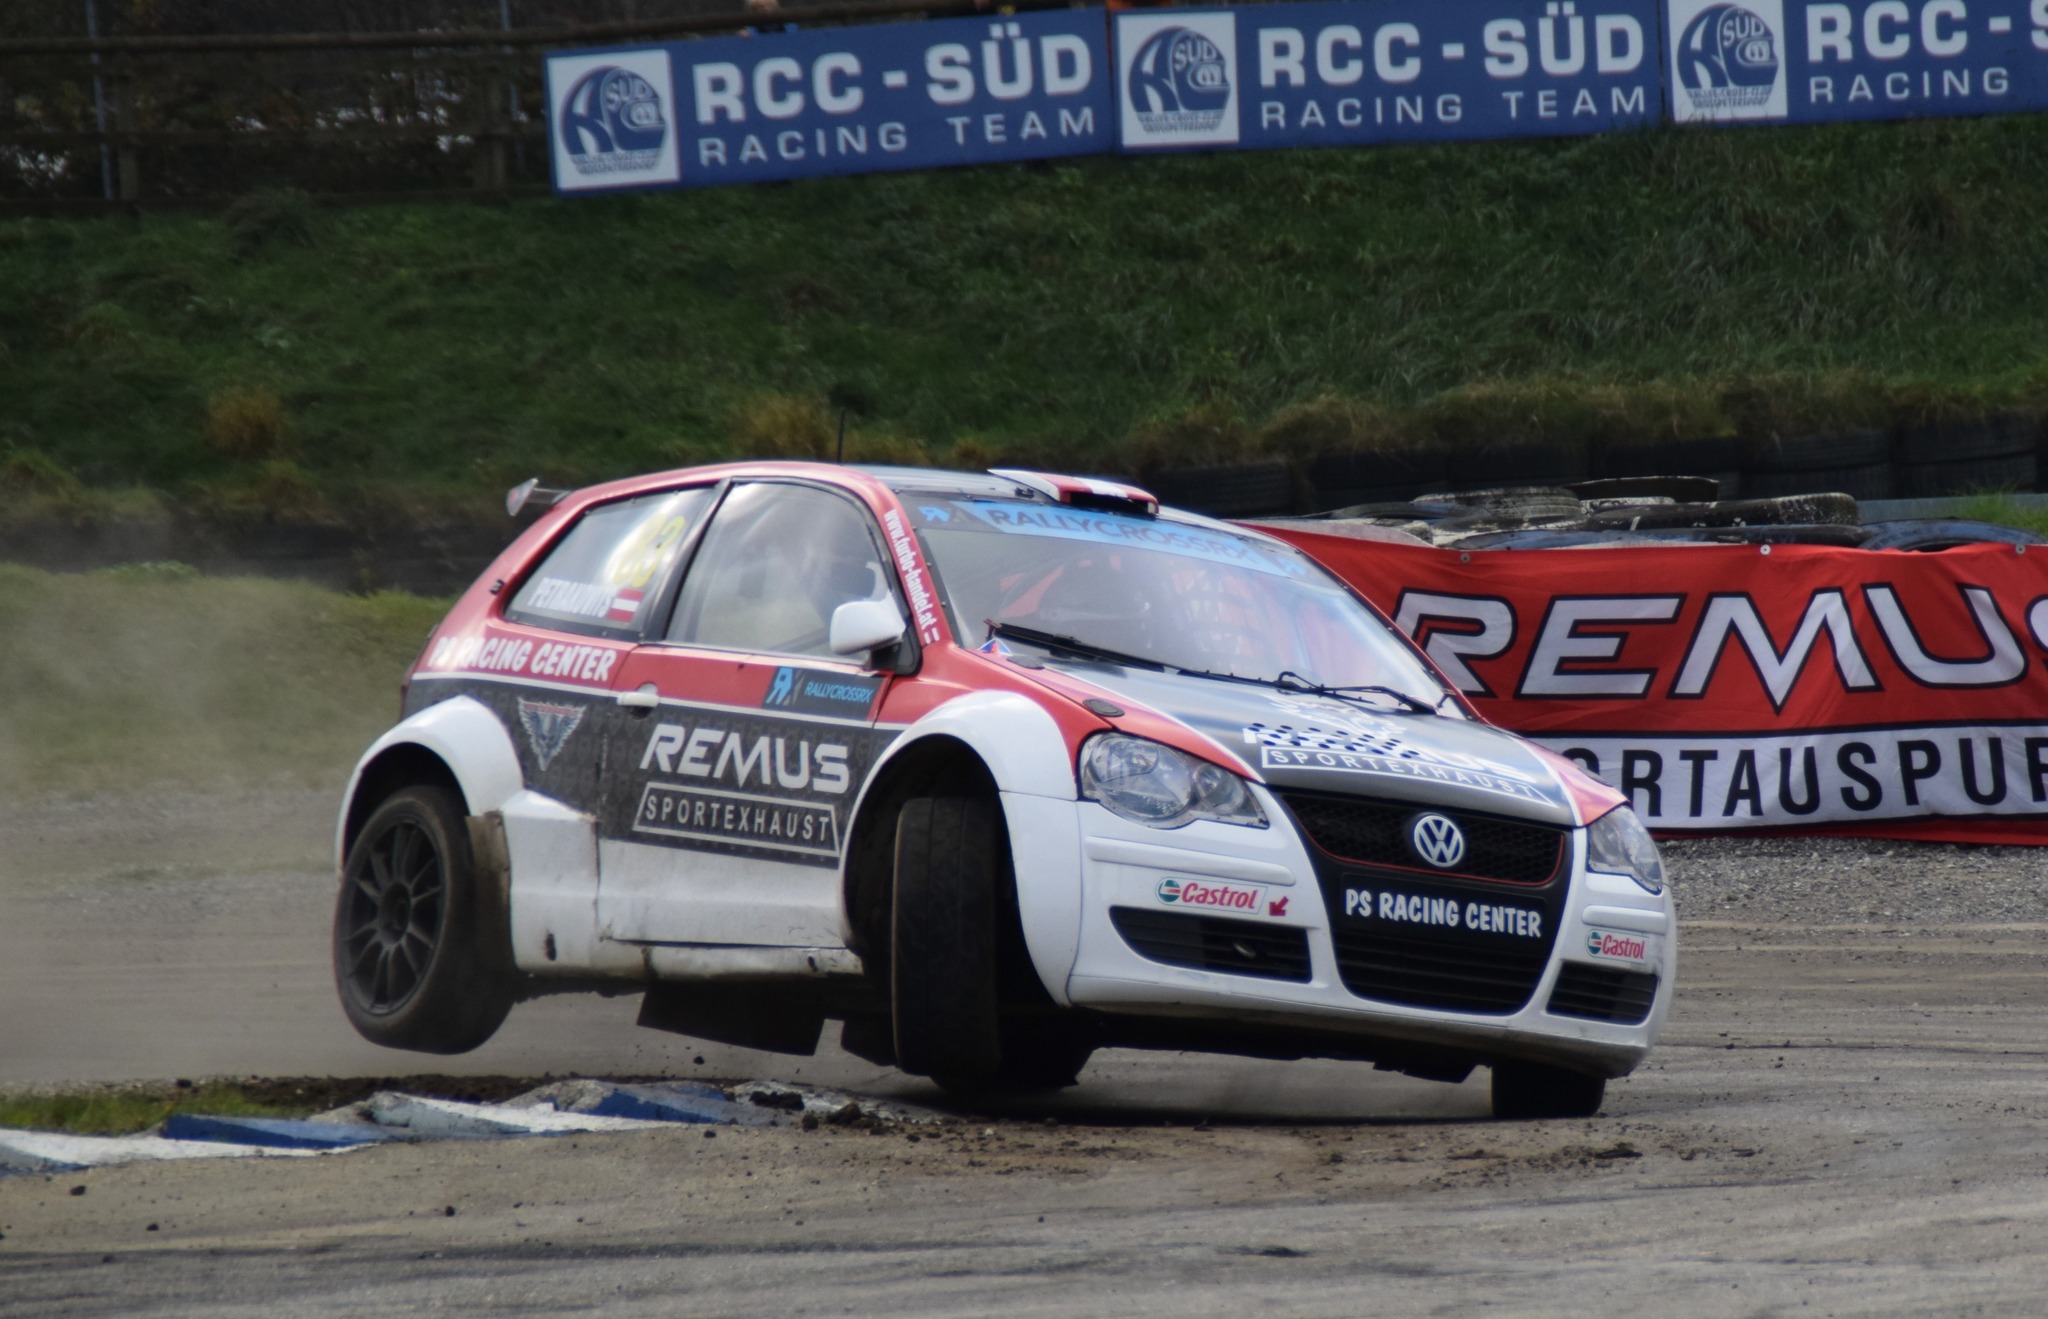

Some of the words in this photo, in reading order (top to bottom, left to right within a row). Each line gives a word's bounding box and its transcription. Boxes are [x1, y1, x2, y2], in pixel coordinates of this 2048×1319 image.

[1258, 22, 1422, 88] RCC
[1483, 1, 1645, 77] SÜD
[1801, 0, 1968, 62] RCC
[692, 52, 864, 125] RCC
[925, 21, 1093, 105] SÜD
[1809, 66, 2010, 104] RACING
[1261, 92, 1463, 130] RACING
[1501, 85, 1645, 119] TEAM
[698, 121, 908, 168] RACING
[946, 106, 1095, 145] TEAM
[454, 636, 533, 673] RACING
[530, 642, 617, 682] CENTER
[1394, 583, 2048, 718] REMU
[639, 723, 849, 794] REMUS
[1274, 749, 1534, 798] SPORTEXHAUST
[645, 796, 831, 842] SPORTEXHAUST
[1181, 882, 1258, 909] Castrol
[1344, 888, 1372, 917] PS
[1378, 891, 1460, 927] RACING
[1464, 906, 1542, 938] CENTER
[1602, 934, 1646, 960] Castrol
